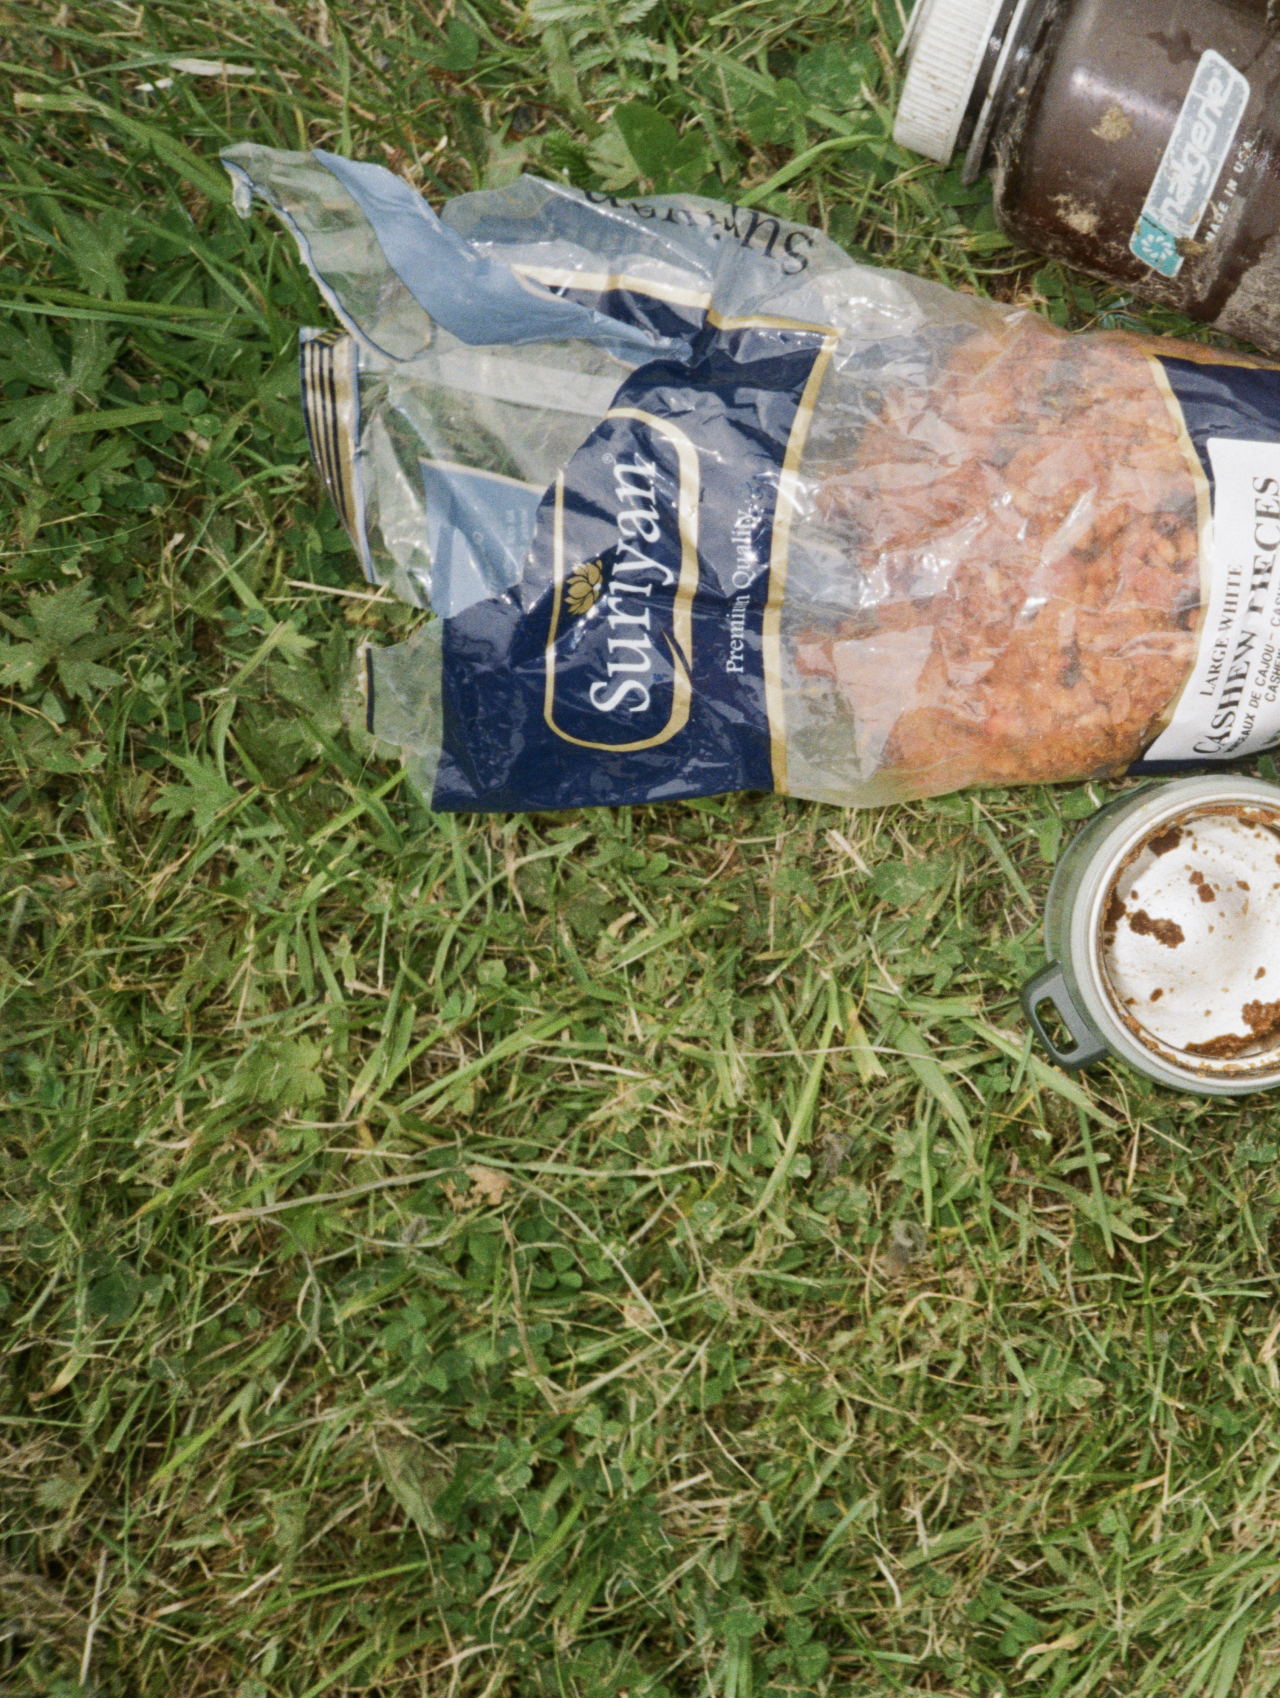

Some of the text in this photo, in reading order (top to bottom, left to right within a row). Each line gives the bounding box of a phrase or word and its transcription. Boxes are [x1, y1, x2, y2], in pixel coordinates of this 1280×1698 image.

[1204, 202, 1229, 242] MADE
[1223, 179, 1238, 198] IN
[589, 458, 674, 713] Suriyan
[726, 509, 758, 673] Premium Quality
[1199, 564, 1243, 697] LARGE WHITE
[1193, 629, 1258, 755] CASHEW
[1249, 692, 1262, 710] DE
[1254, 643, 1275, 690] CAJOU
